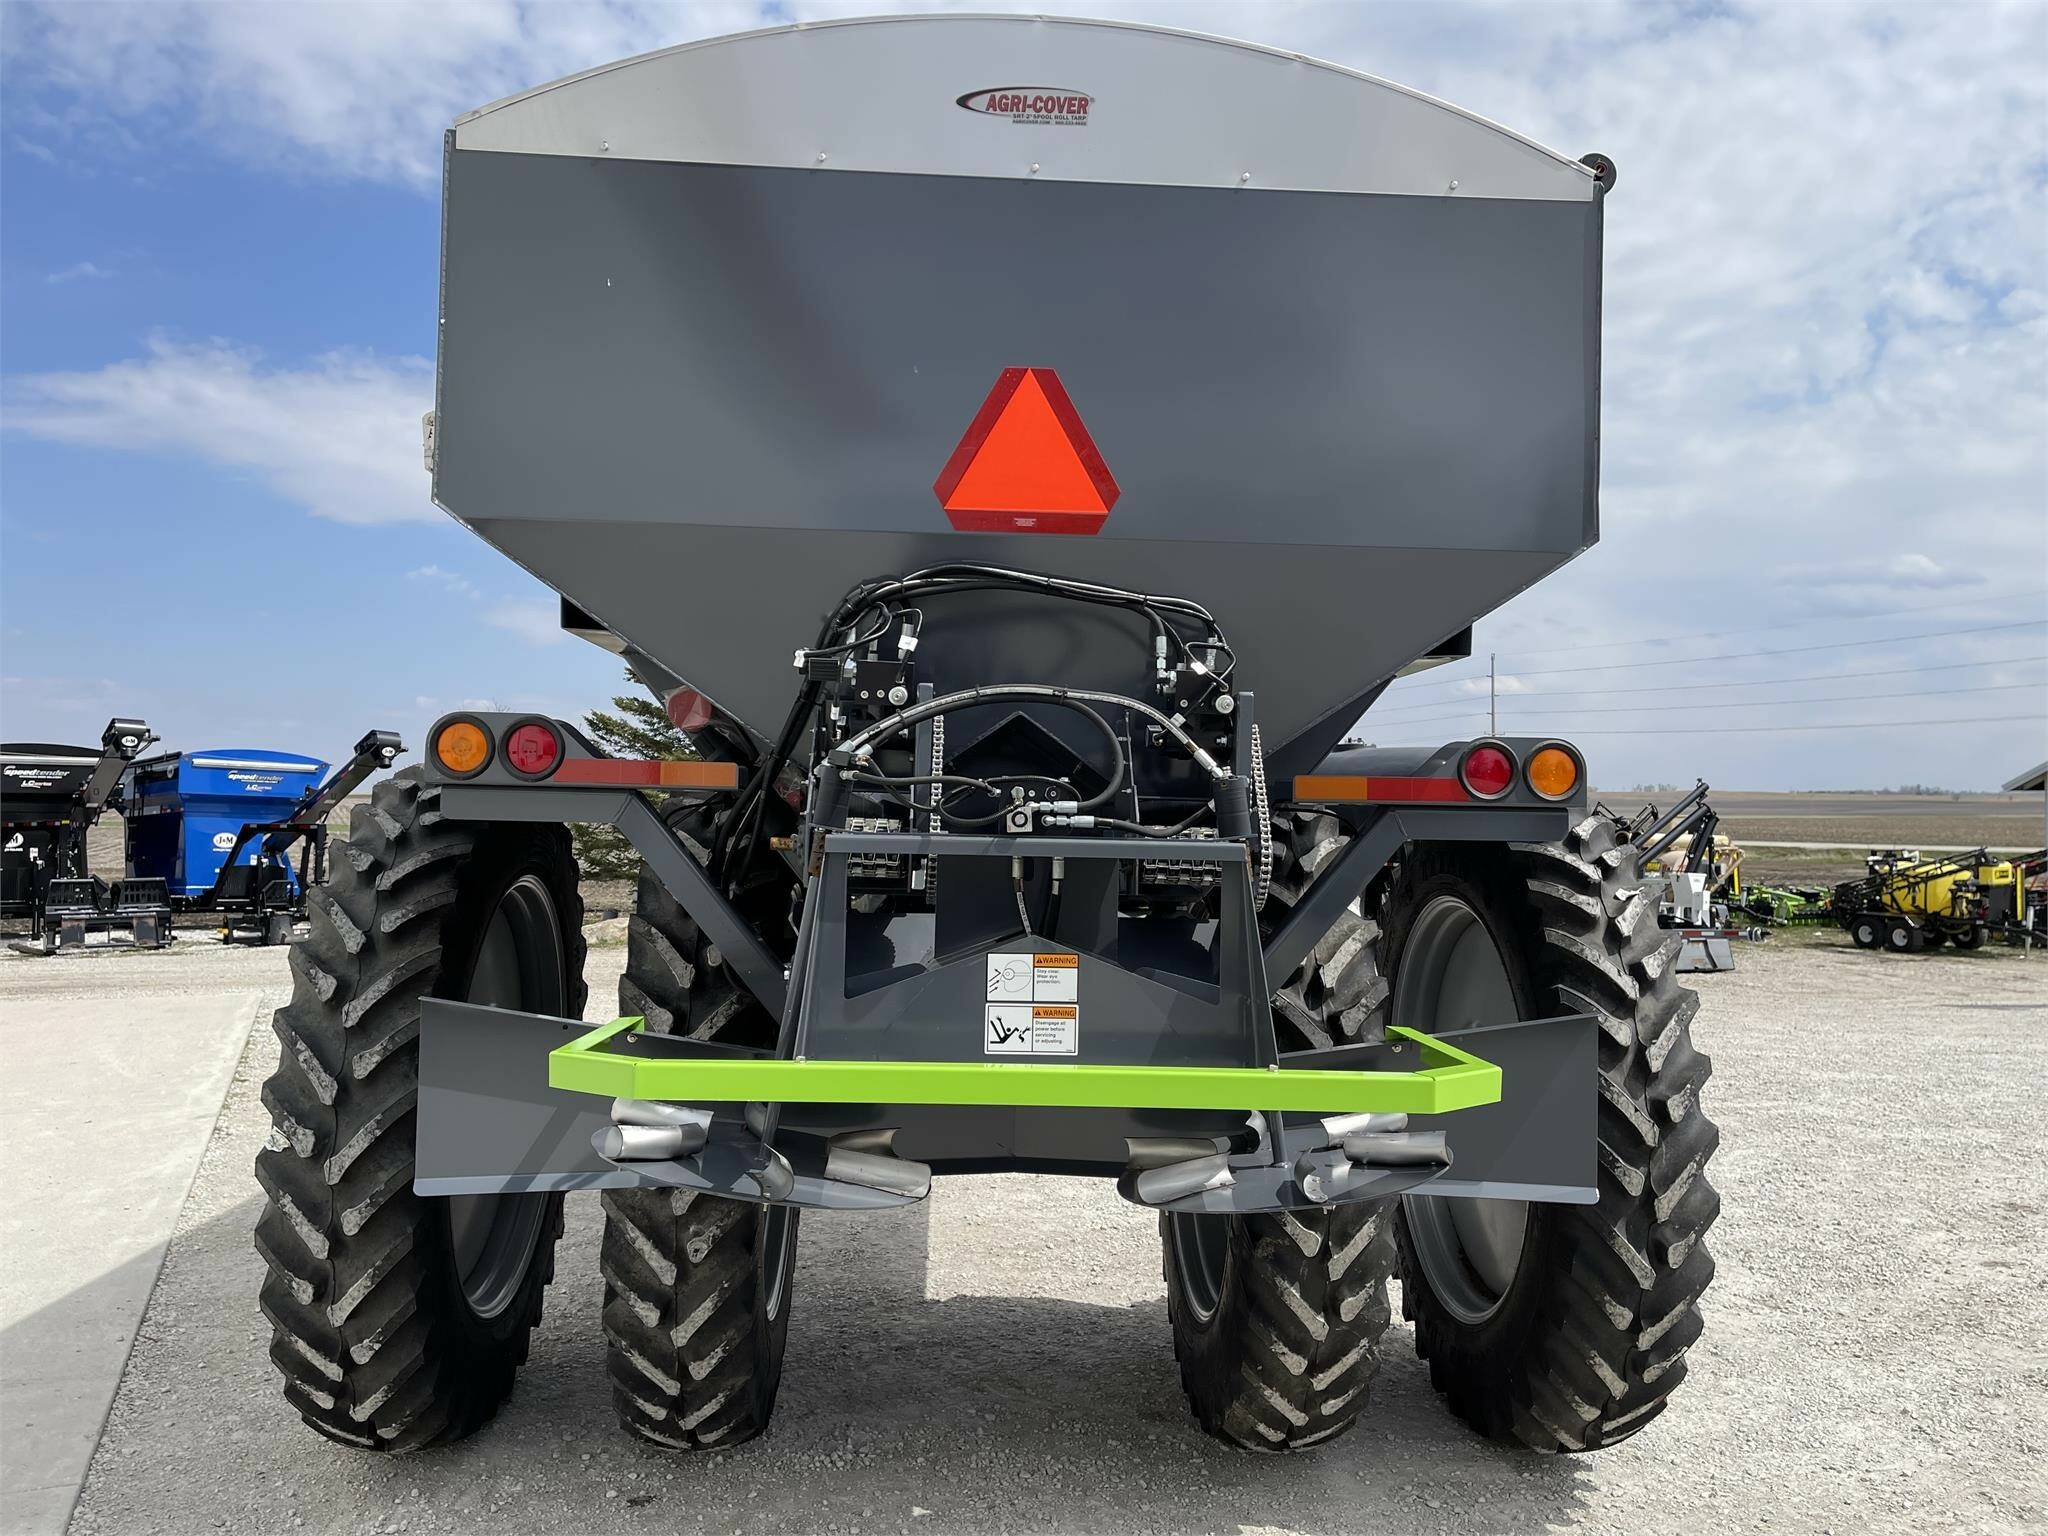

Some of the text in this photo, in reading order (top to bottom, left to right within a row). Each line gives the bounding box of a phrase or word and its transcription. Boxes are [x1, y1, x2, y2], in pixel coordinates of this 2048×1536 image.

[985, 94, 1088, 115] AGRI-COVER
[1042, 957, 1077, 965] WARNING
[1042, 1009, 1075, 1017] WARNING
